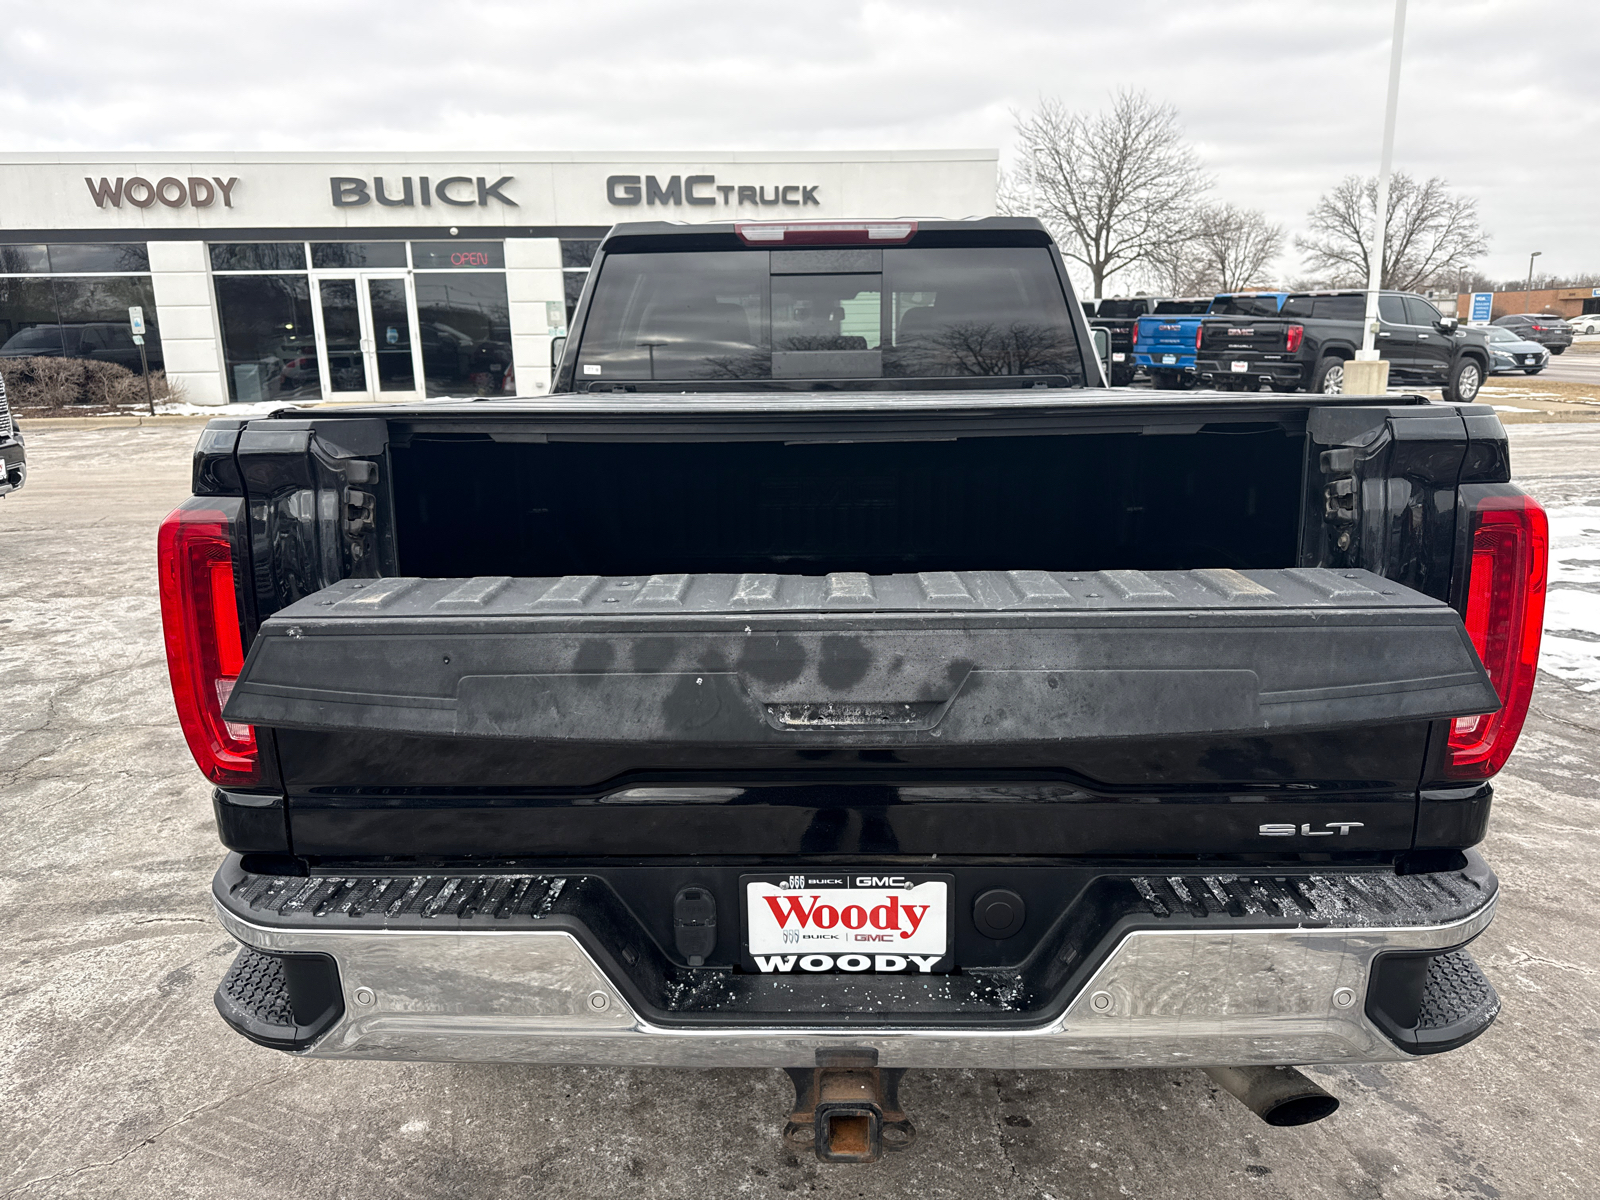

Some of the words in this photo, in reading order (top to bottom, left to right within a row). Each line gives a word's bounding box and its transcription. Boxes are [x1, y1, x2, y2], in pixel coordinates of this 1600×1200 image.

[84, 176, 239, 208] WOODY
[329, 176, 520, 207] BUICK
[606, 175, 717, 206] GMC
[716, 185, 821, 206] TRUCK
[450, 252, 488, 266] OPEN
[1227, 328, 1255, 336] GMC
[1258, 822, 1365, 837] SLT
[856, 876, 906, 887] GMC
[762, 895, 930, 940] Woody
[854, 934, 894, 943] GMC
[753, 954, 943, 973] WOODY
